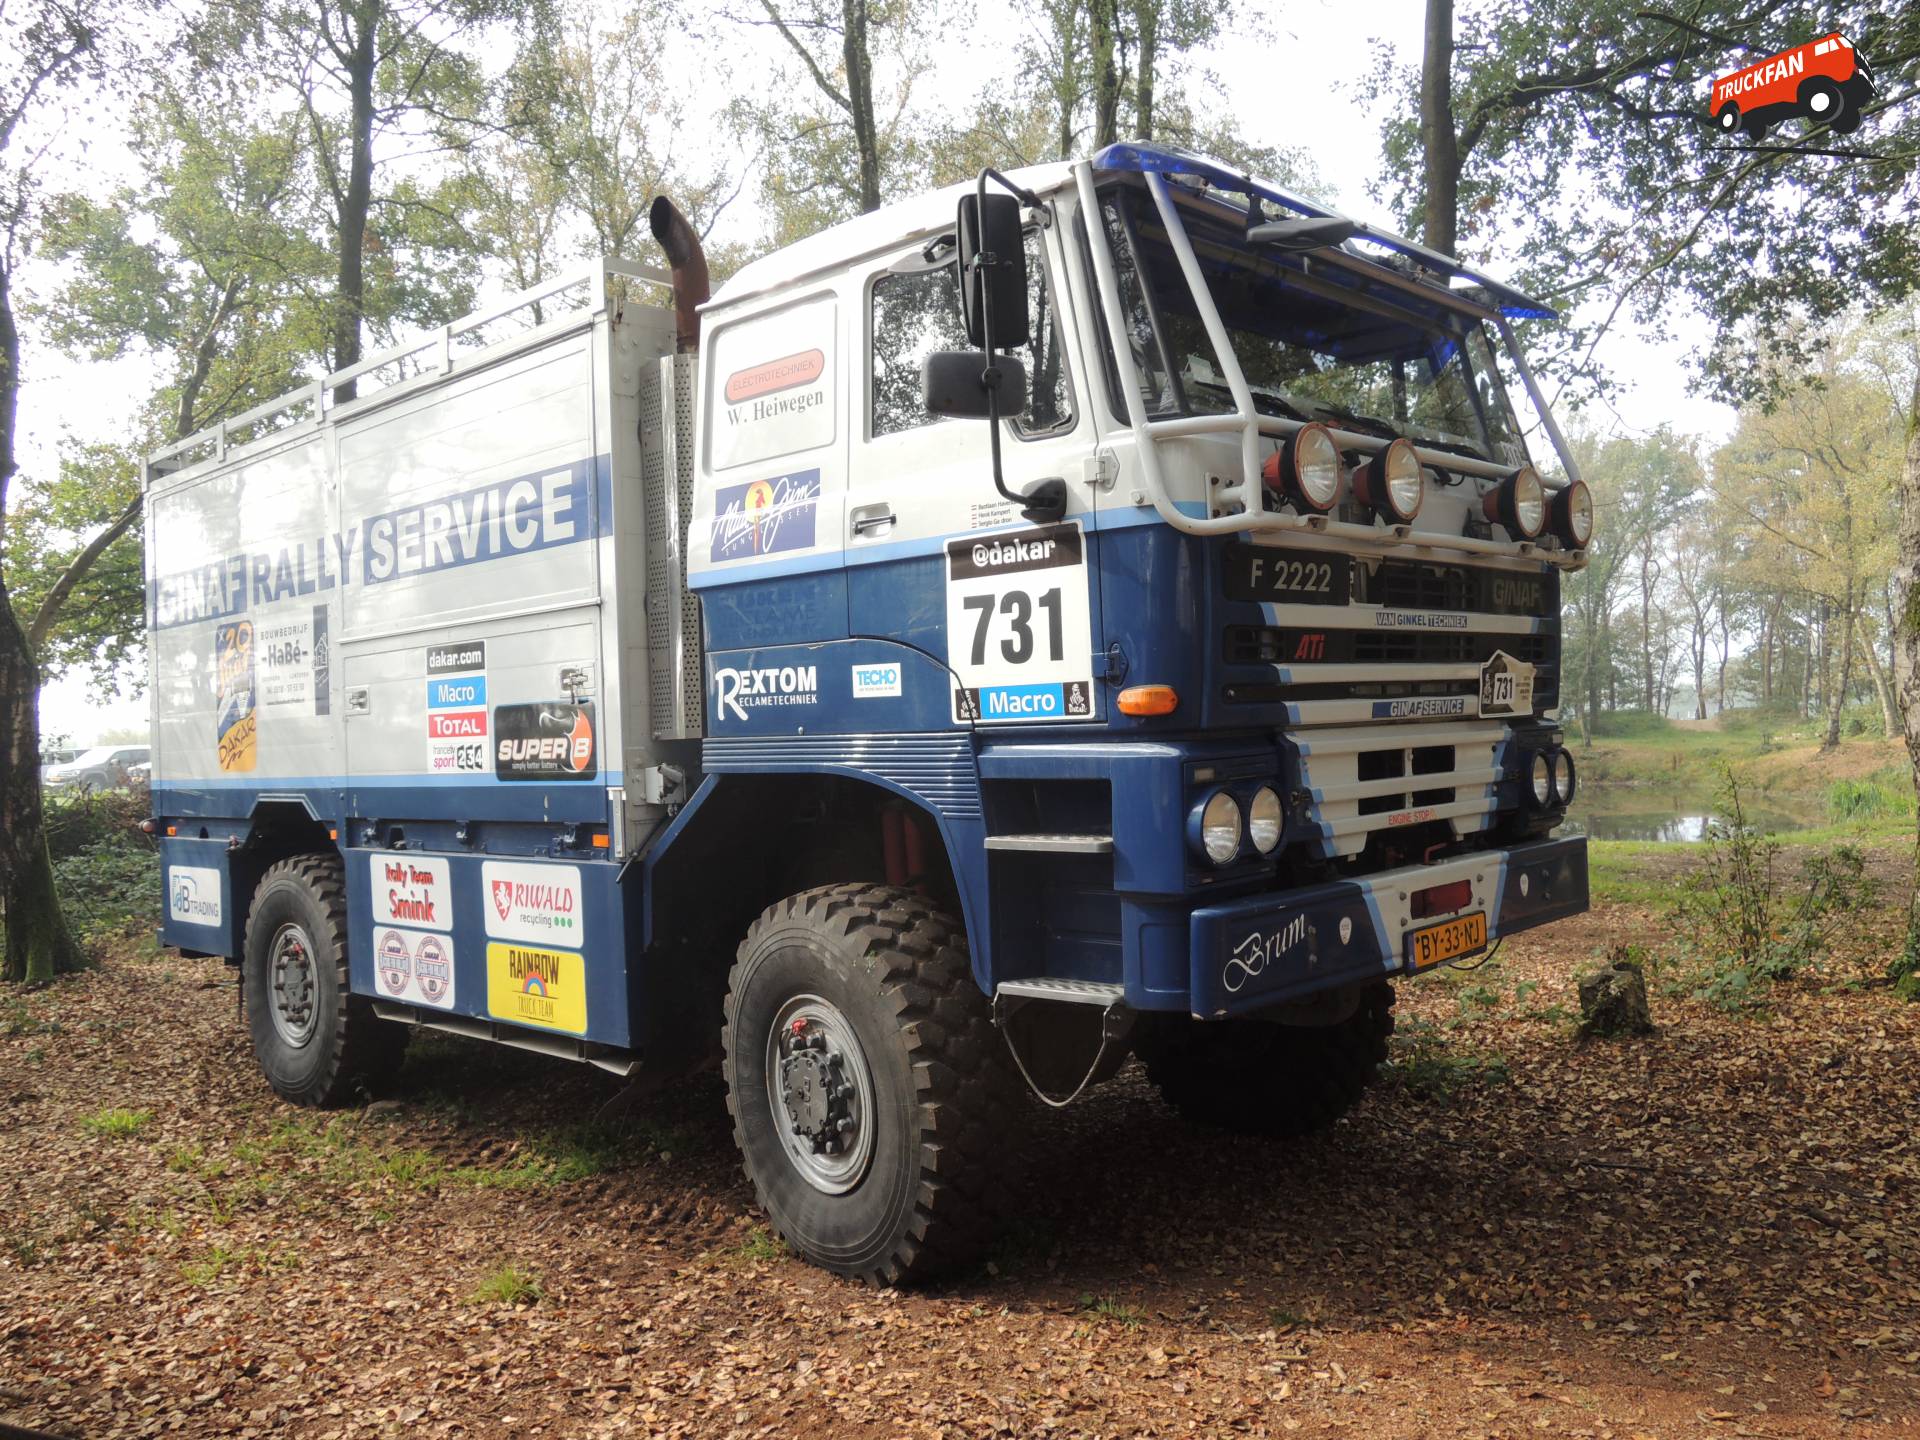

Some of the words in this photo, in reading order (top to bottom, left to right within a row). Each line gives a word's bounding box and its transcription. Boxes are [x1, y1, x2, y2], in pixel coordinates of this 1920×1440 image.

[732, 358, 816, 392] ELECTROTECHNIEK
[727, 408, 748, 426] W.
[753, 390, 824, 421] Heiwegen
[370, 469, 575, 579] SERVICE
[971, 537, 1057, 568] @dakar
[1250, 558, 1263, 588] F
[1273, 560, 1333, 592] 2222
[260, 623, 309, 641] BOUWBEDRIJF
[963, 587, 1064, 666] 731
[1377, 613, 1395, 626] VAN
[1397, 614, 1427, 626] GINKEL
[1428, 616, 1467, 628] TECHNIEK
[428, 650, 482, 668] dakar.com
[856, 669, 897, 686] TECHO
[1496, 677, 1513, 700] 731
[438, 684, 475, 703] Macro
[715, 665, 817, 721] REXTOM
[989, 691, 1056, 714] Macro
[434, 716, 481, 735] TOTAL
[218, 717, 256, 764] DAKAR
[498, 737, 569, 761] SUPER
[574, 737, 590, 758] B
[433, 756, 455, 770] sport
[1388, 812, 1412, 826] ENGINE
[1414, 809, 1431, 822] STOP
[385, 862, 407, 887] Rally
[409, 864, 434, 886] Team
[190, 900, 219, 917] TRADING
[388, 888, 436, 923] Smink
[514, 883, 573, 913] RIWALD
[520, 912, 552, 928] recycling
[509, 949, 560, 985] RAINBOW
[518, 995, 536, 1014] TRUCK
[537, 998, 554, 1018] TEAM
